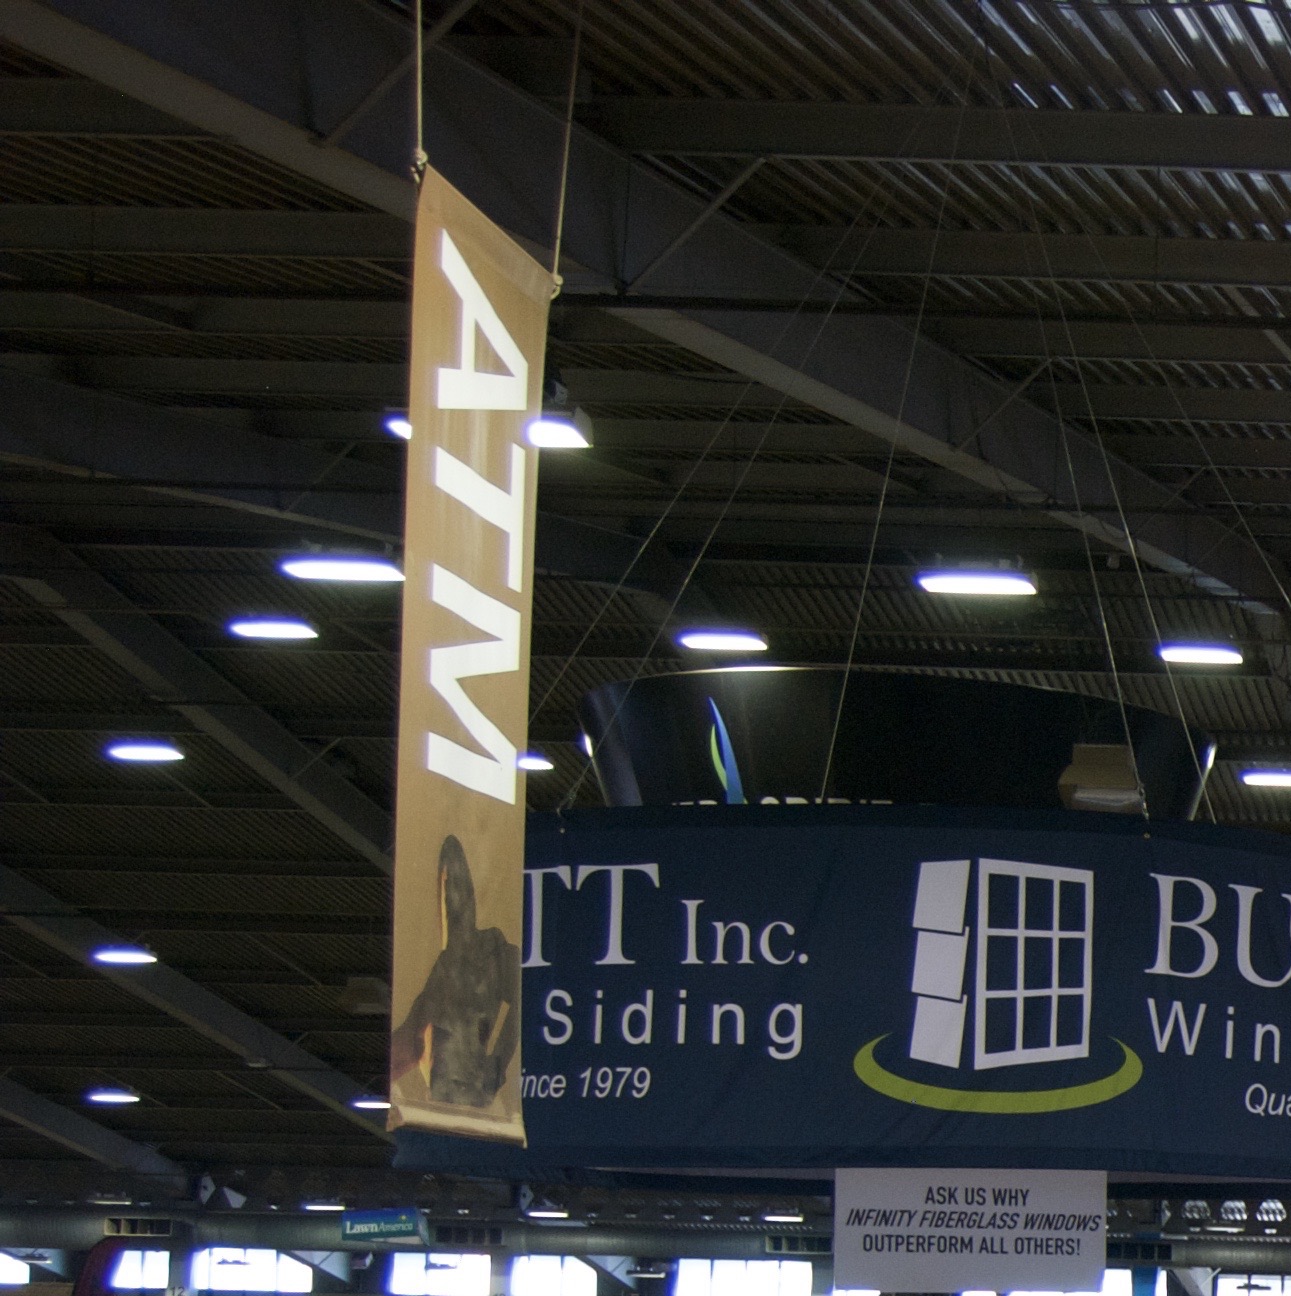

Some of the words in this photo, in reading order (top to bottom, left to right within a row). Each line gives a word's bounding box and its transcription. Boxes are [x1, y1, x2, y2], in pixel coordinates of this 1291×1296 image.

[427, 228, 528, 804] ATM
[680, 899, 810, 967] Inc.
[542, 989, 804, 1060] Siding
[519, 1068, 567, 1099] ince
[579, 1066, 651, 1099] 1979
[925, 1186, 958, 1205] ASK
[964, 1187, 986, 1206] US
[992, 1188, 1029, 1207] WHY
[846, 1208, 918, 1228] INFINITY
[919, 1210, 1020, 1230] FIBERGLASS
[1023, 1213, 1102, 1232] WINDOWS
[862, 1233, 973, 1253] OUTPERFORM
[979, 1237, 1008, 1254] ALL
[1014, 1238, 1081, 1255] OTHERS!
